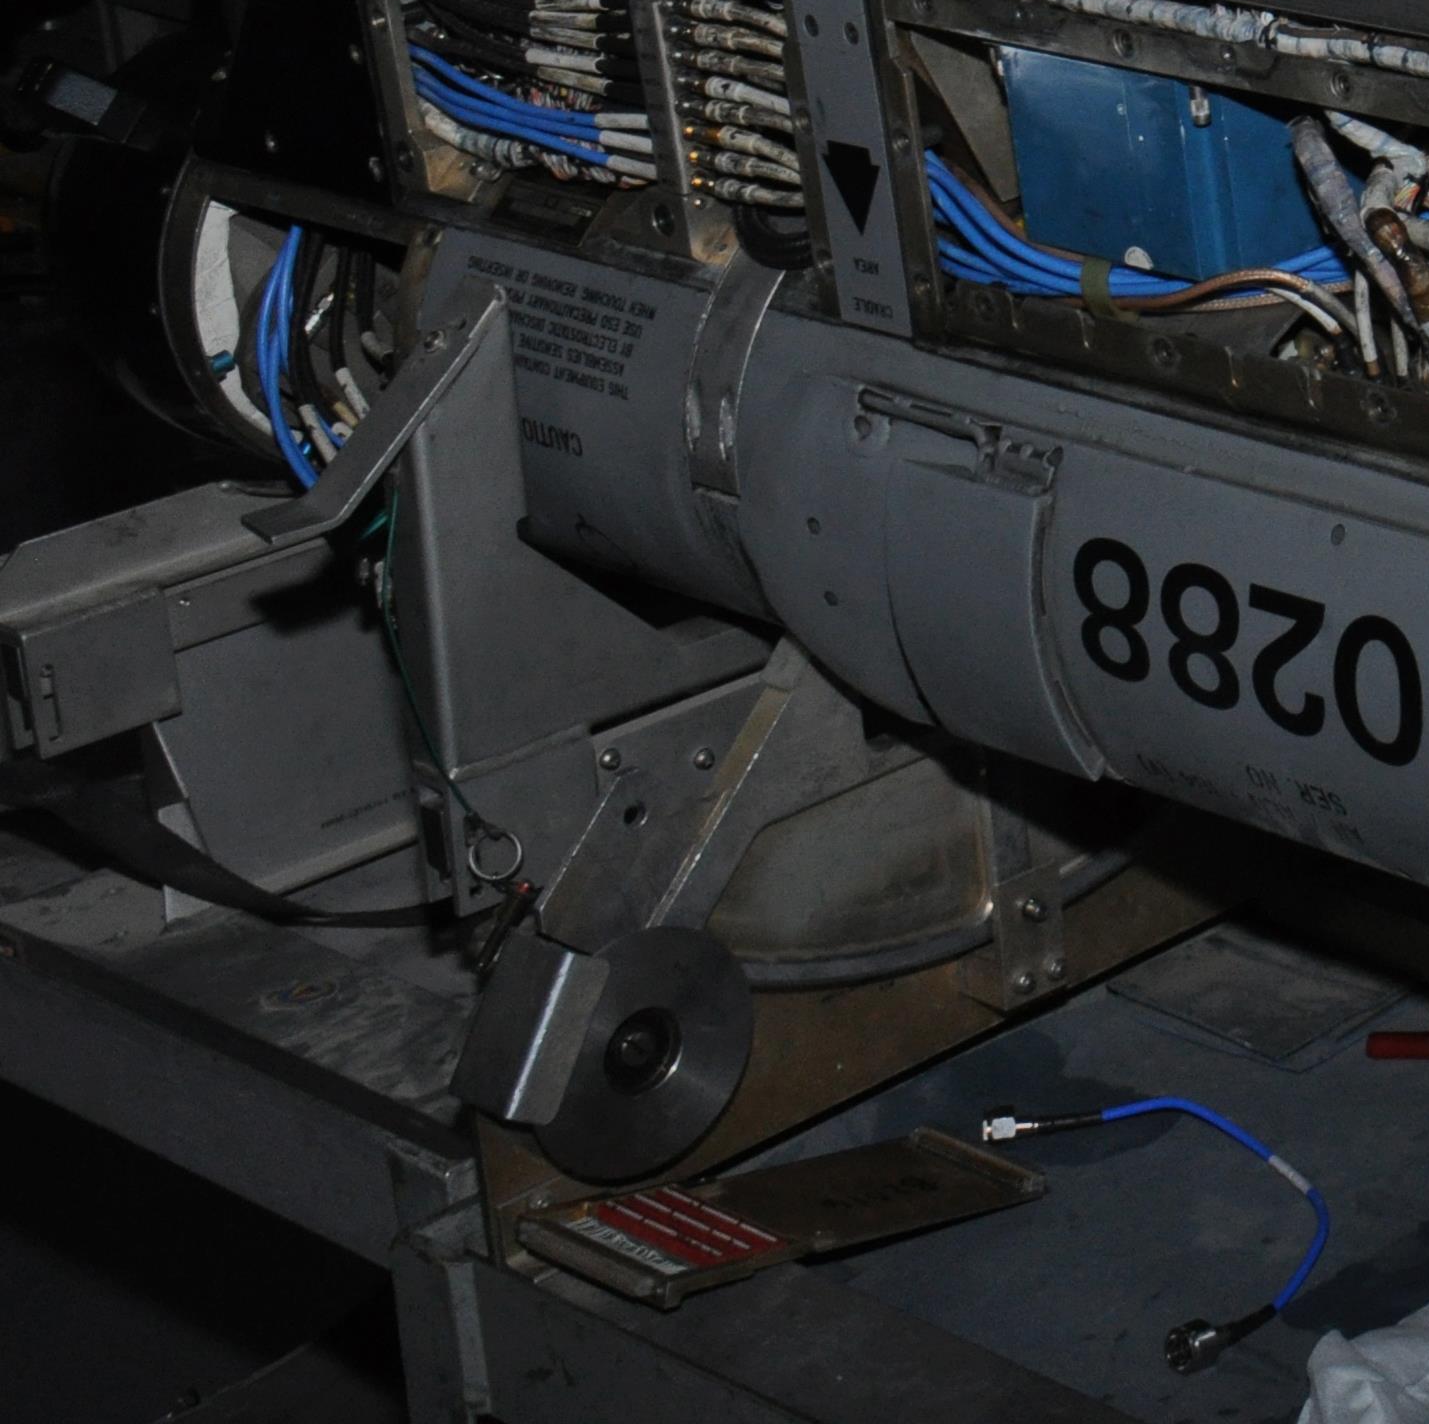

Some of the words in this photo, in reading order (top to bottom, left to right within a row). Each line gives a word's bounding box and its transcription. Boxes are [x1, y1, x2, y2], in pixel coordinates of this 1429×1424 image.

[853, 256, 881, 278] AREA
[853, 296, 894, 321] CRADLE
[520, 417, 583, 457] CAUTIO
[1072, 537, 1423, 768] 0288
